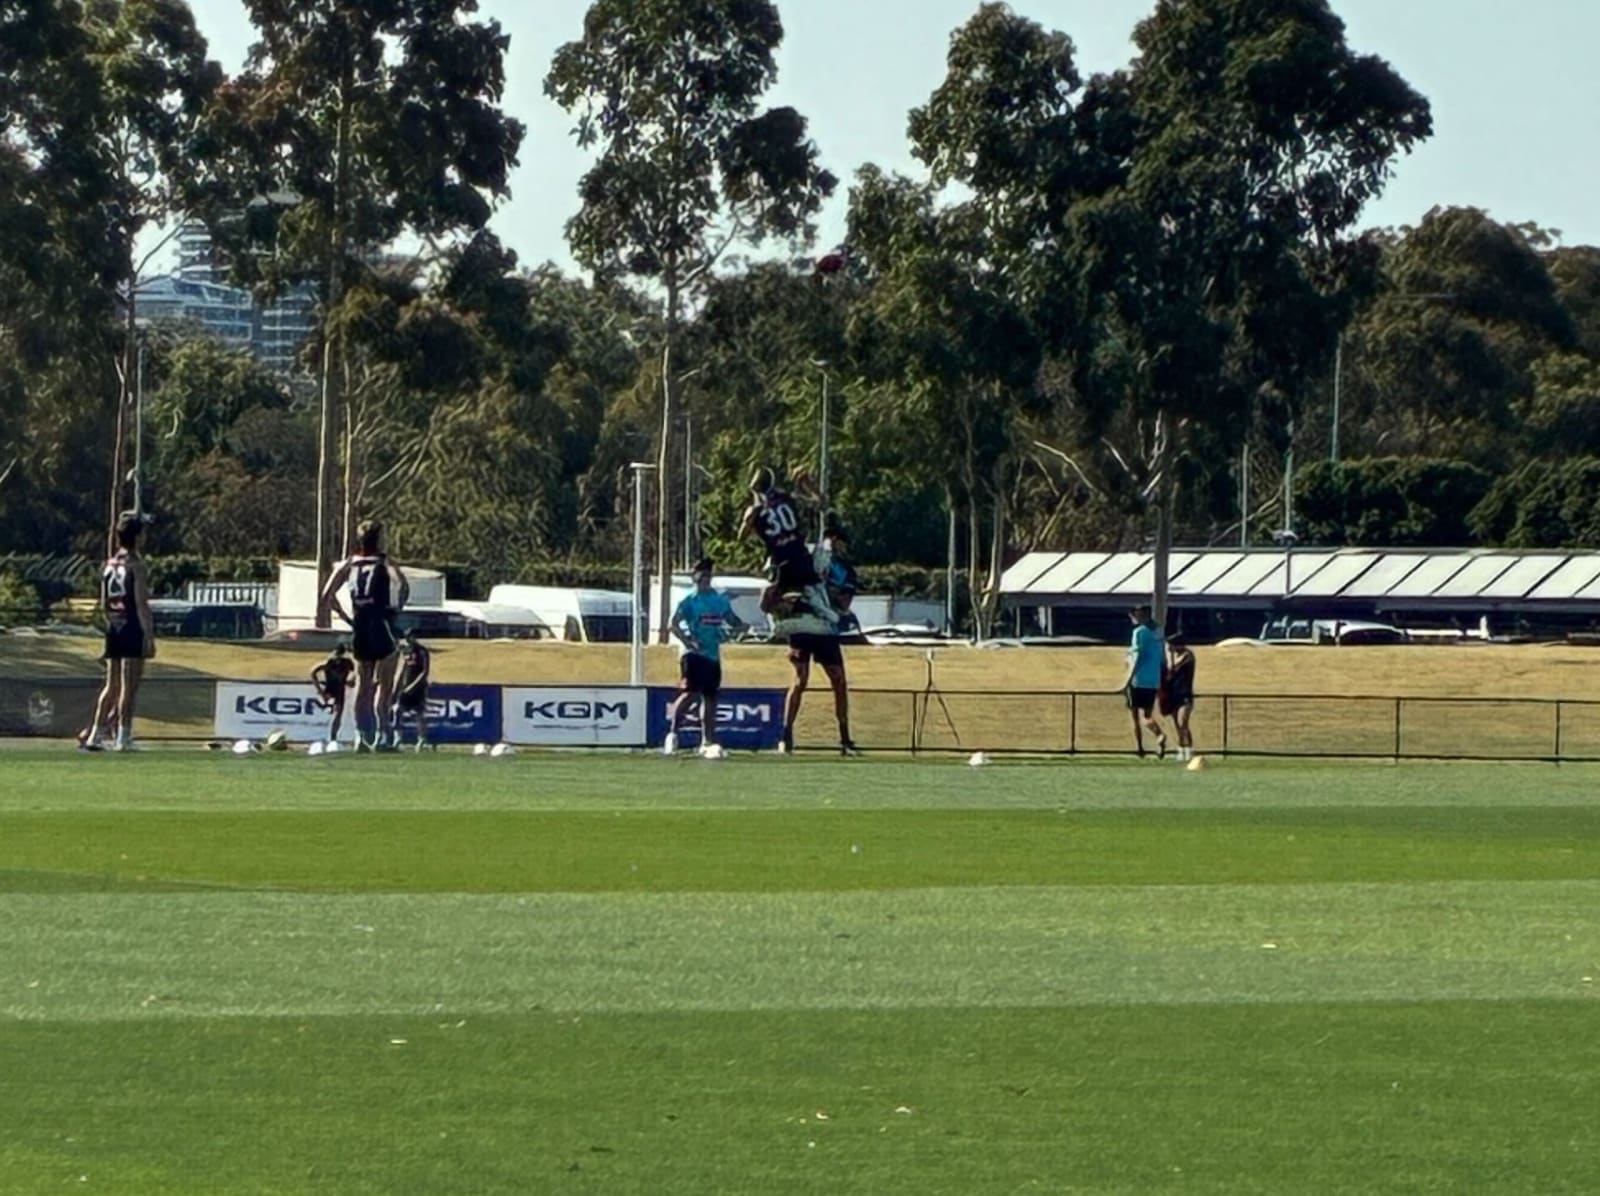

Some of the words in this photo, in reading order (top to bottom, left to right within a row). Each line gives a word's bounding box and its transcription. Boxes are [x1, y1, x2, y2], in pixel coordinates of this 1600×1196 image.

[760, 503, 797, 536] 30
[350, 563, 377, 597] 17
[524, 701, 628, 720] KGM
